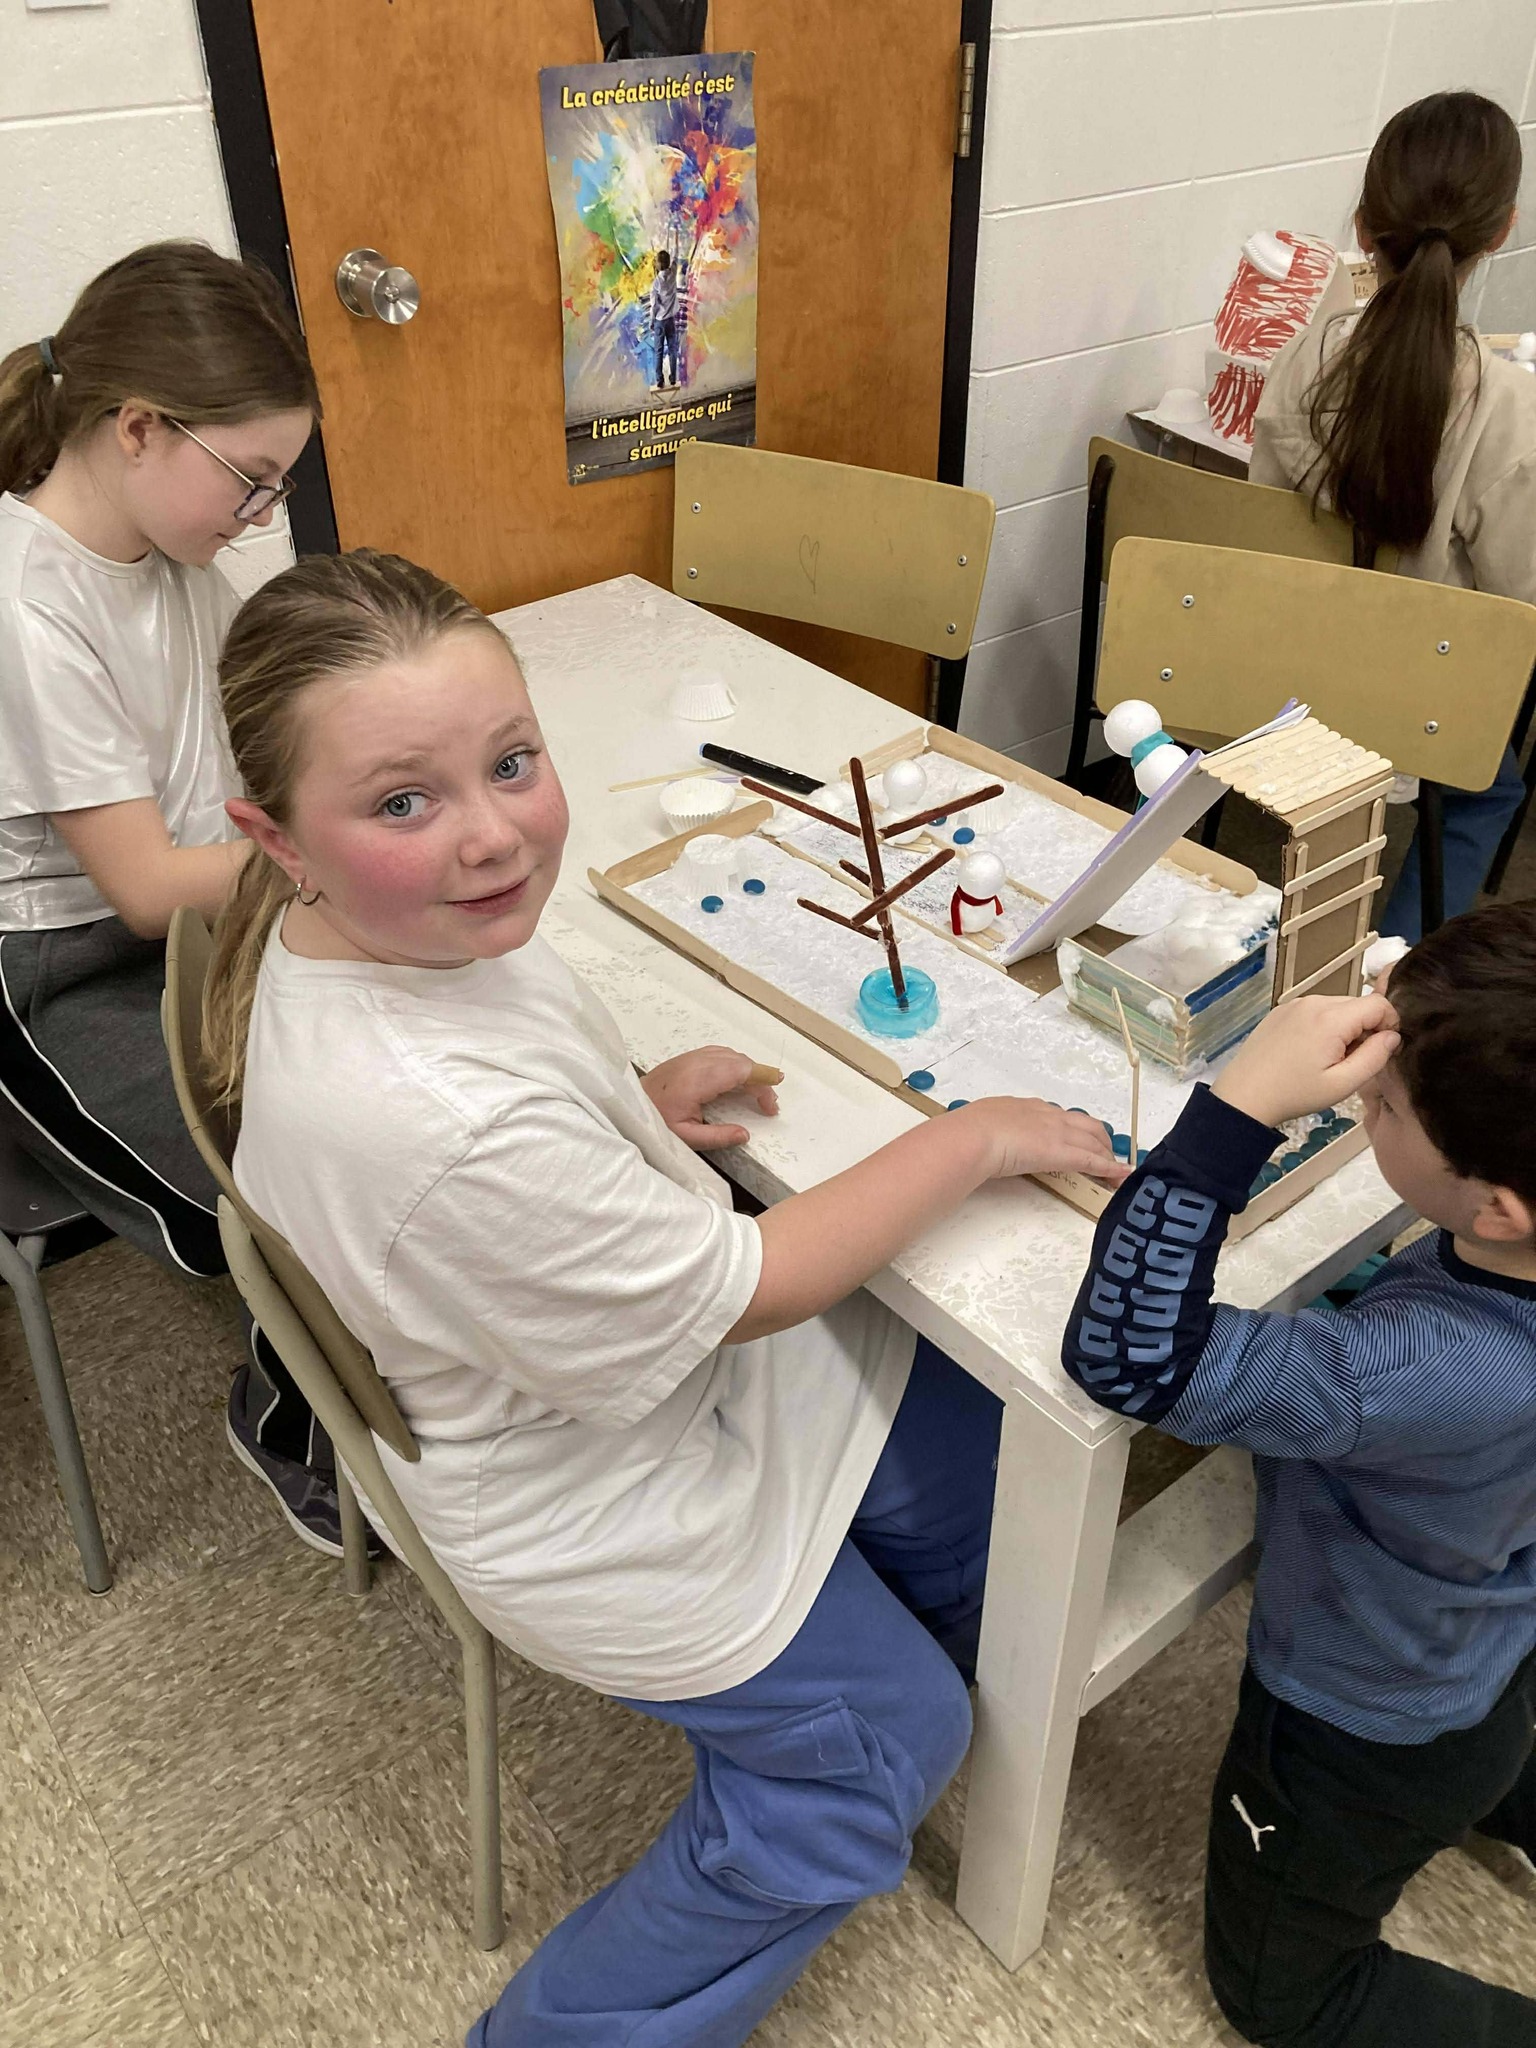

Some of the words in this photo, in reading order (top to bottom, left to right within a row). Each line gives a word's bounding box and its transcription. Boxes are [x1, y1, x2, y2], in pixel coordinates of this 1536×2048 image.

[562, 86, 588, 109] La
[592, 73, 691, 107] créativité
[694, 71, 736, 96] c'est
[592, 404, 704, 440] l'intelligence
[707, 393, 733, 421] qui
